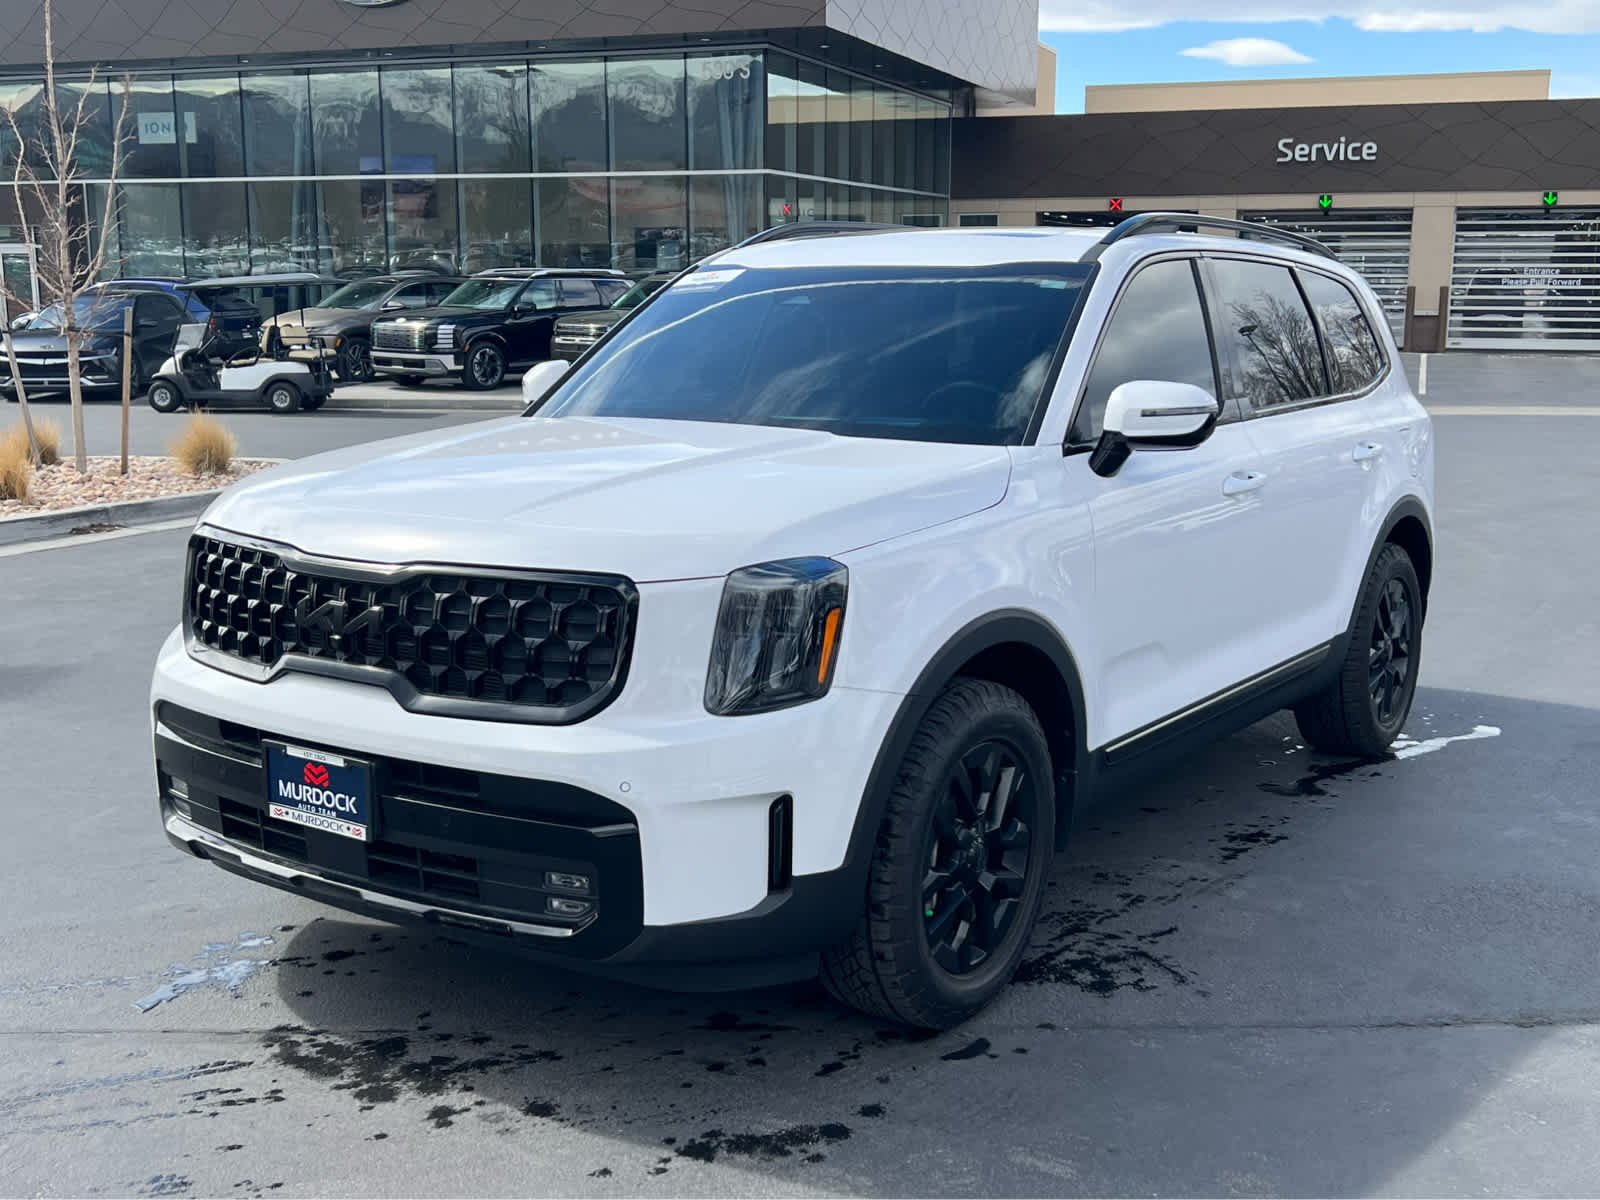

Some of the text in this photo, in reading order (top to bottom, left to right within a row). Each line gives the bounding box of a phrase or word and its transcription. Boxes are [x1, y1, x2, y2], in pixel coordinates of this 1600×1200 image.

[1276, 136, 1378, 162] Service
[1523, 267, 1561, 276] Entrance
[1501, 277, 1582, 287] Please Pull Forward
[278, 779, 358, 814] MURDOCK
[298, 802, 337, 818] AUTO TEAM
[291, 811, 345, 833] MURDOCK
